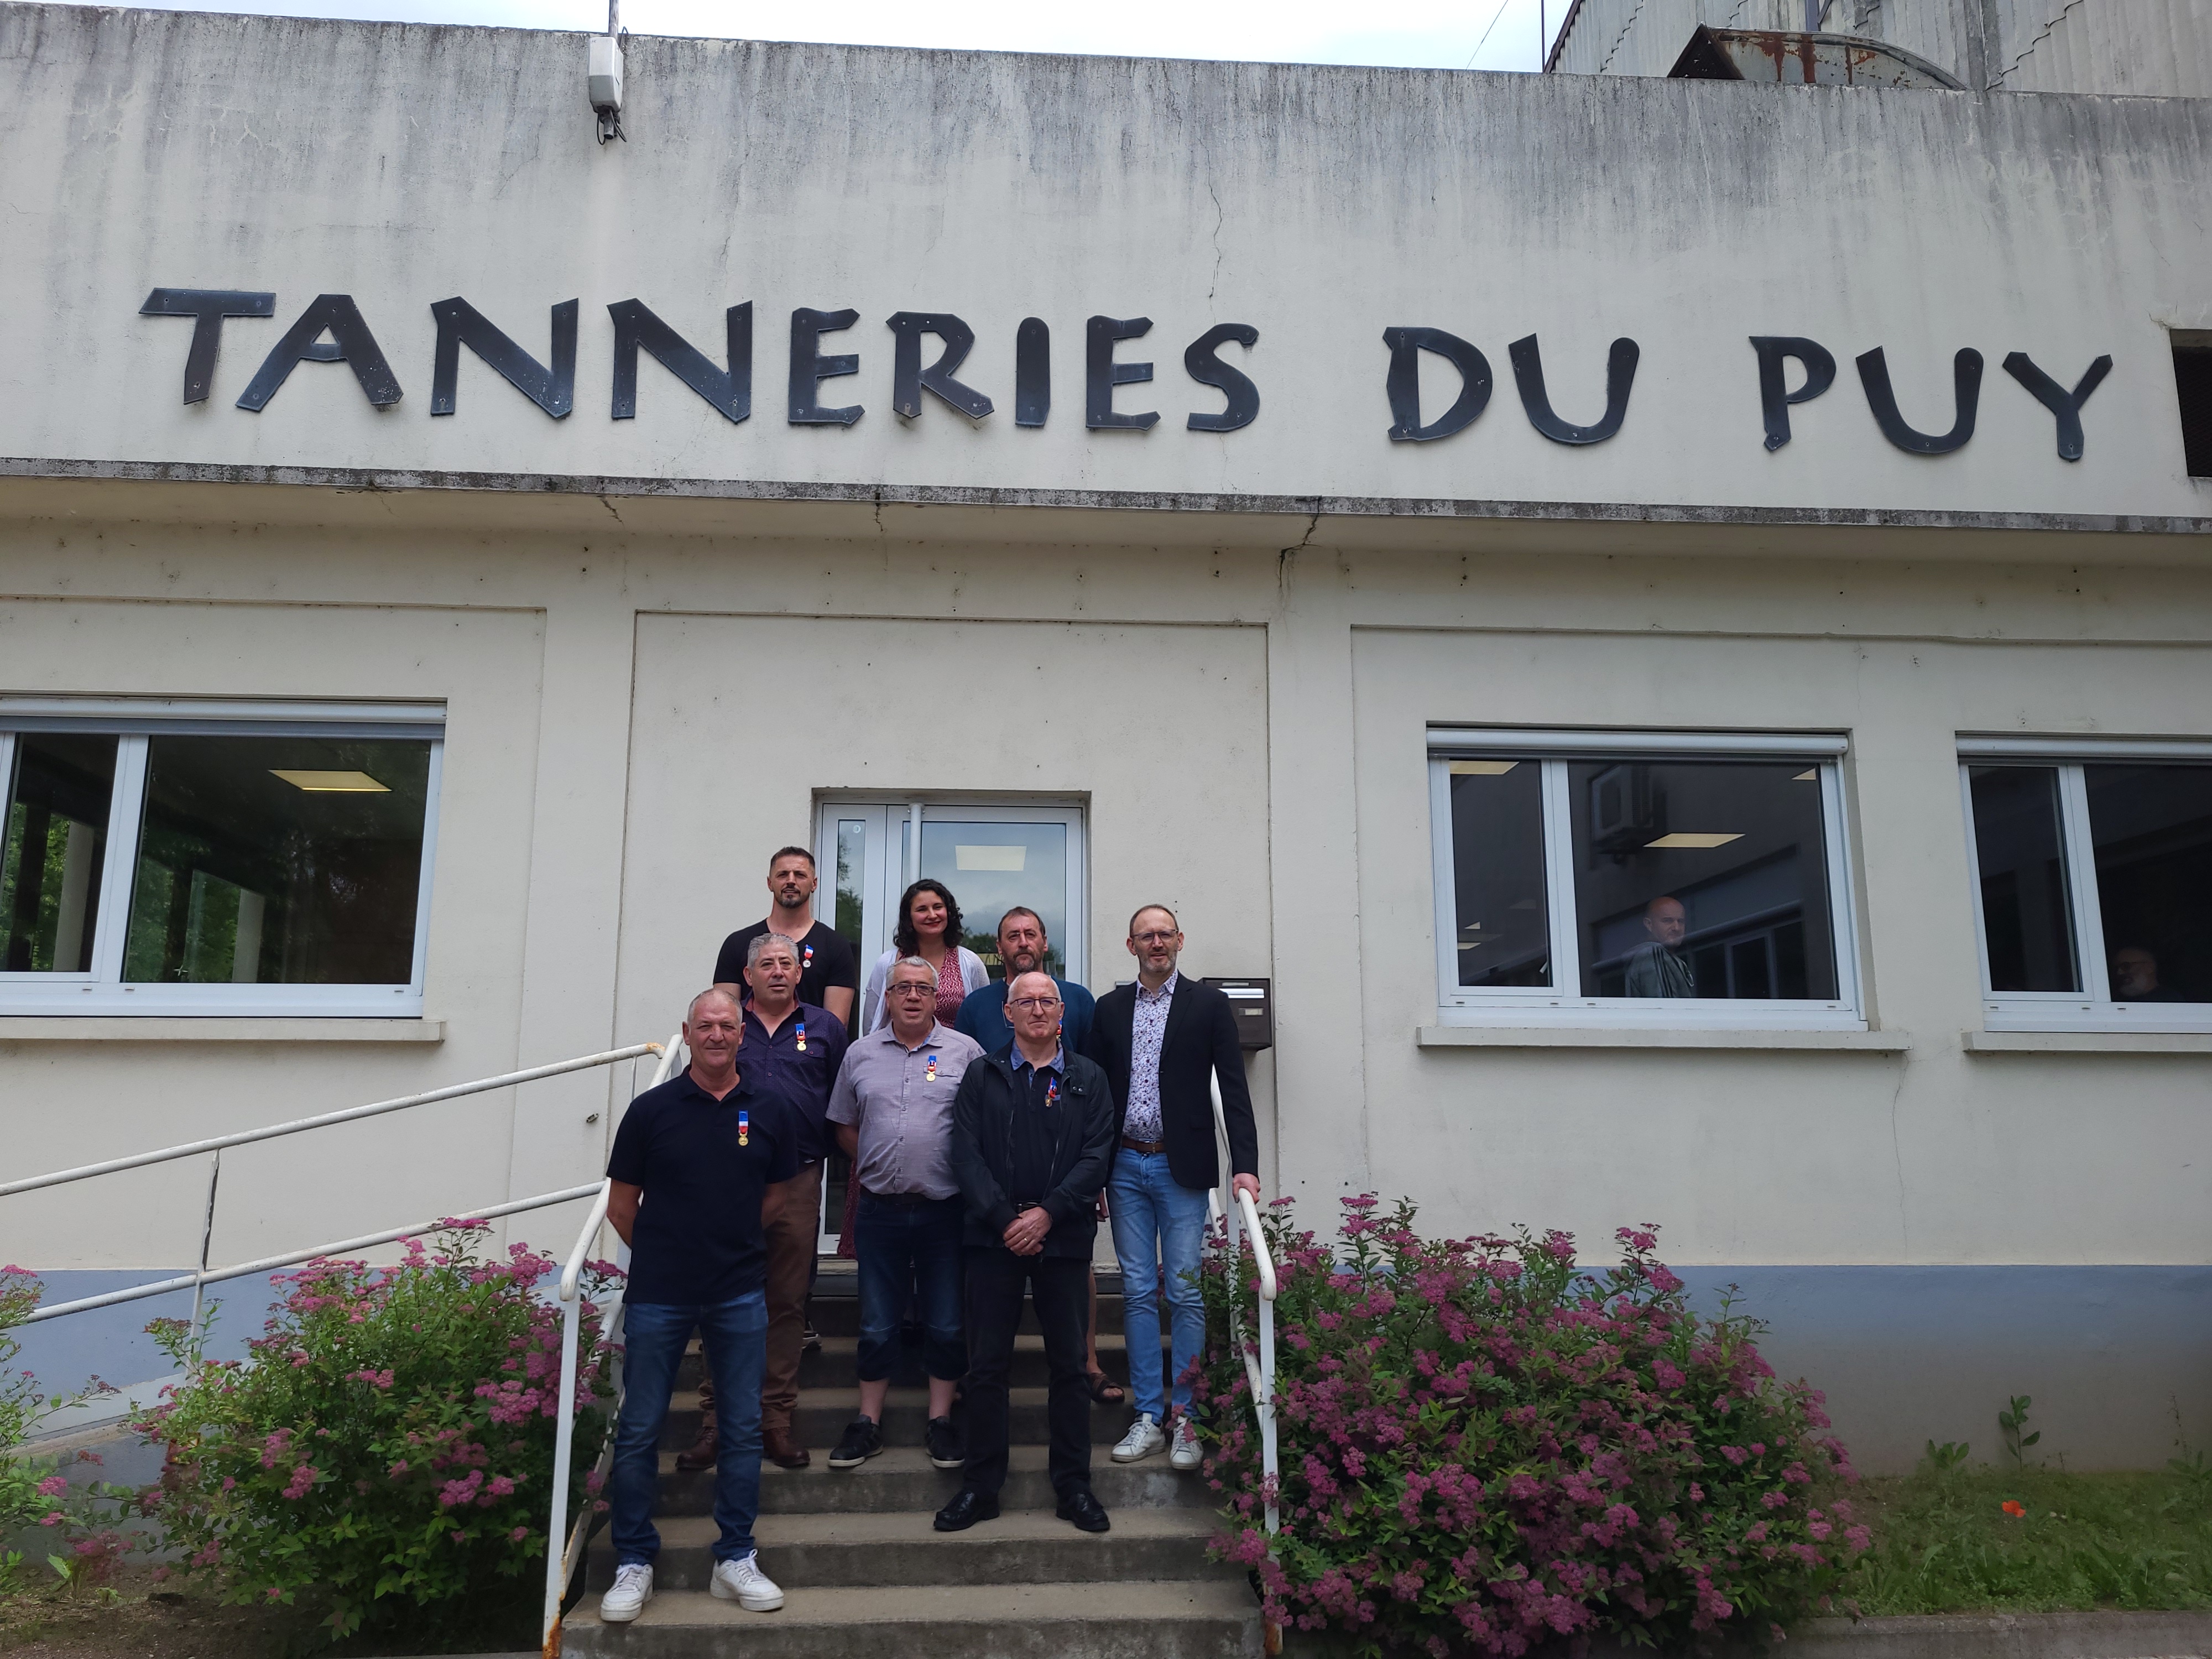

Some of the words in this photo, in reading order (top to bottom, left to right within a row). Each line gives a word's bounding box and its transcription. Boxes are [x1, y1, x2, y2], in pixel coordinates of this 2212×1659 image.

[139, 288, 1260, 436] TANNERIES
[1383, 327, 1640, 449] DU
[1749, 336, 2113, 463] PUY
